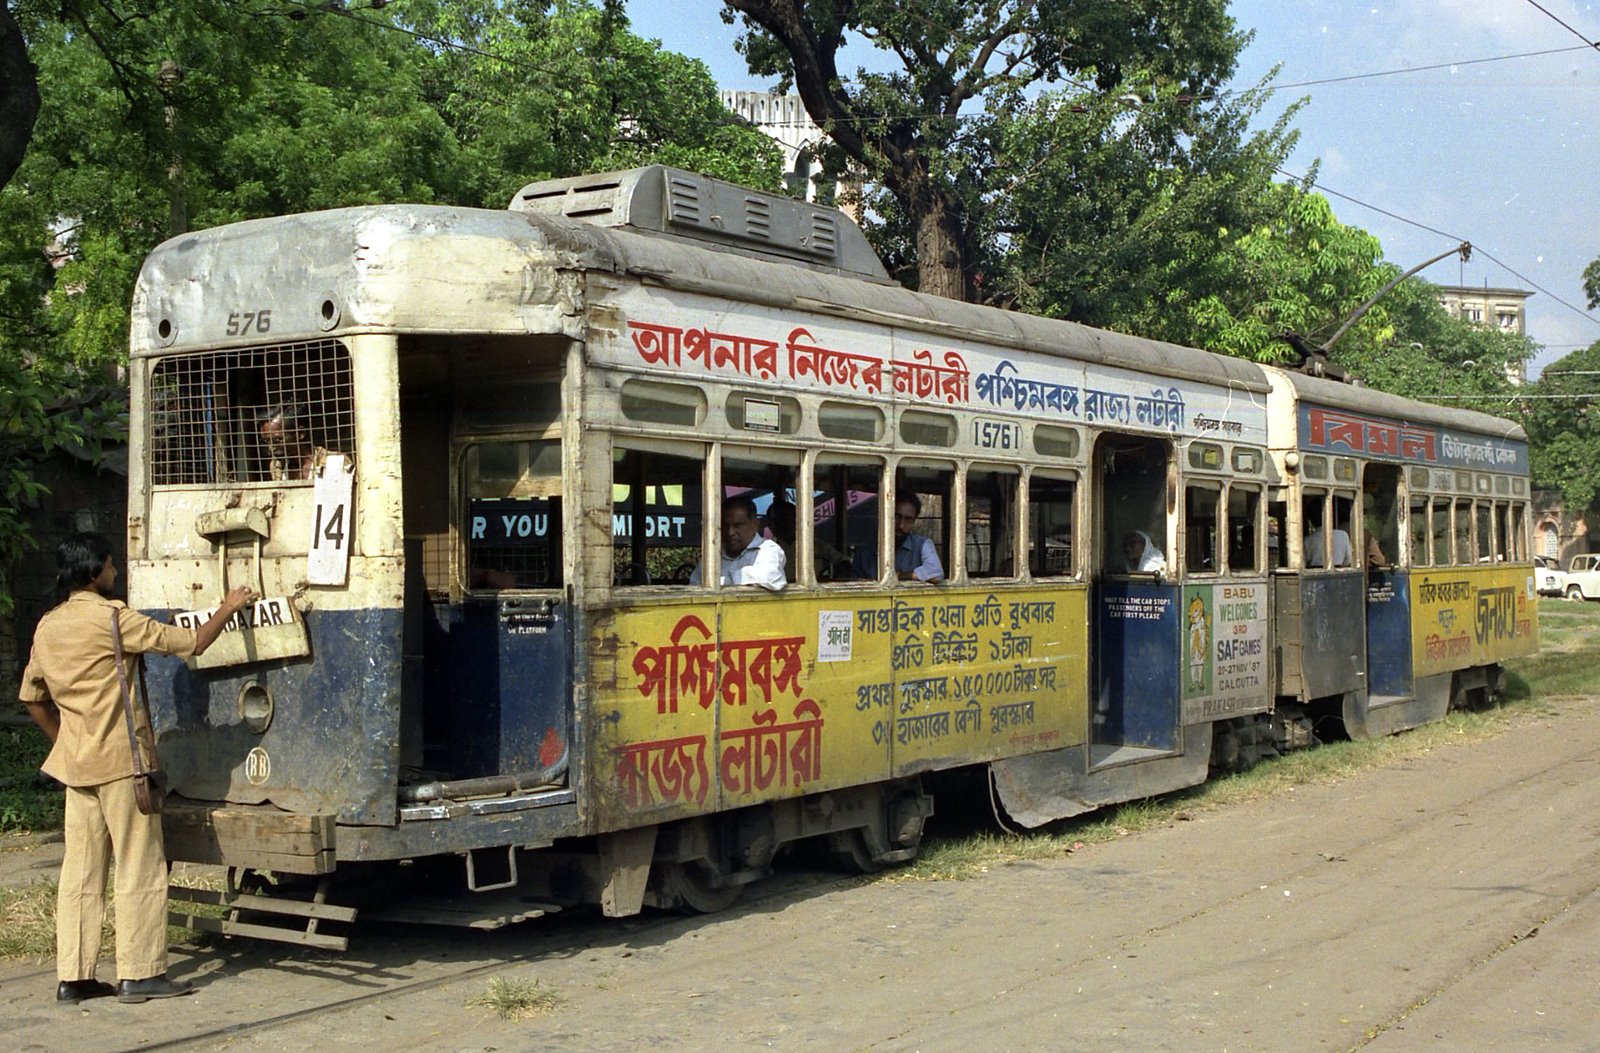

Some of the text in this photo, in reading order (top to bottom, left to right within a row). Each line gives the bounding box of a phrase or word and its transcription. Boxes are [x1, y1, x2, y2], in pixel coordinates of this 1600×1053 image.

[226, 309, 271, 336] 576
[627, 320, 970, 403] আপনার নিজের লটারী
[975, 360, 1185, 430] পশ্চিমবঙ্গ রাজ্য লটারী
[1309, 408, 1437, 462] বিমল
[313, 504, 345, 550] 14
[1224, 588, 1255, 599] BABU
[932, 604, 966, 629] খেলা
[972, 594, 1001, 628] প্রতি
[1009, 601, 1056, 629] বুধবার
[1139, 612, 1160, 620] PLEASE
[1219, 602, 1257, 622] WELCOMES
[519, 626, 547, 635] PLATFORM
[1233, 624, 1248, 635] 3RD
[632, 614, 806, 715] পশ্চিমবঙ্গ
[892, 634, 924, 670] প্রতি
[1217, 639, 1262, 661] SAF GAMES
[1219, 675, 1260, 691] CALCUTTA
[614, 699, 824, 808] রাজ্য লটারী
